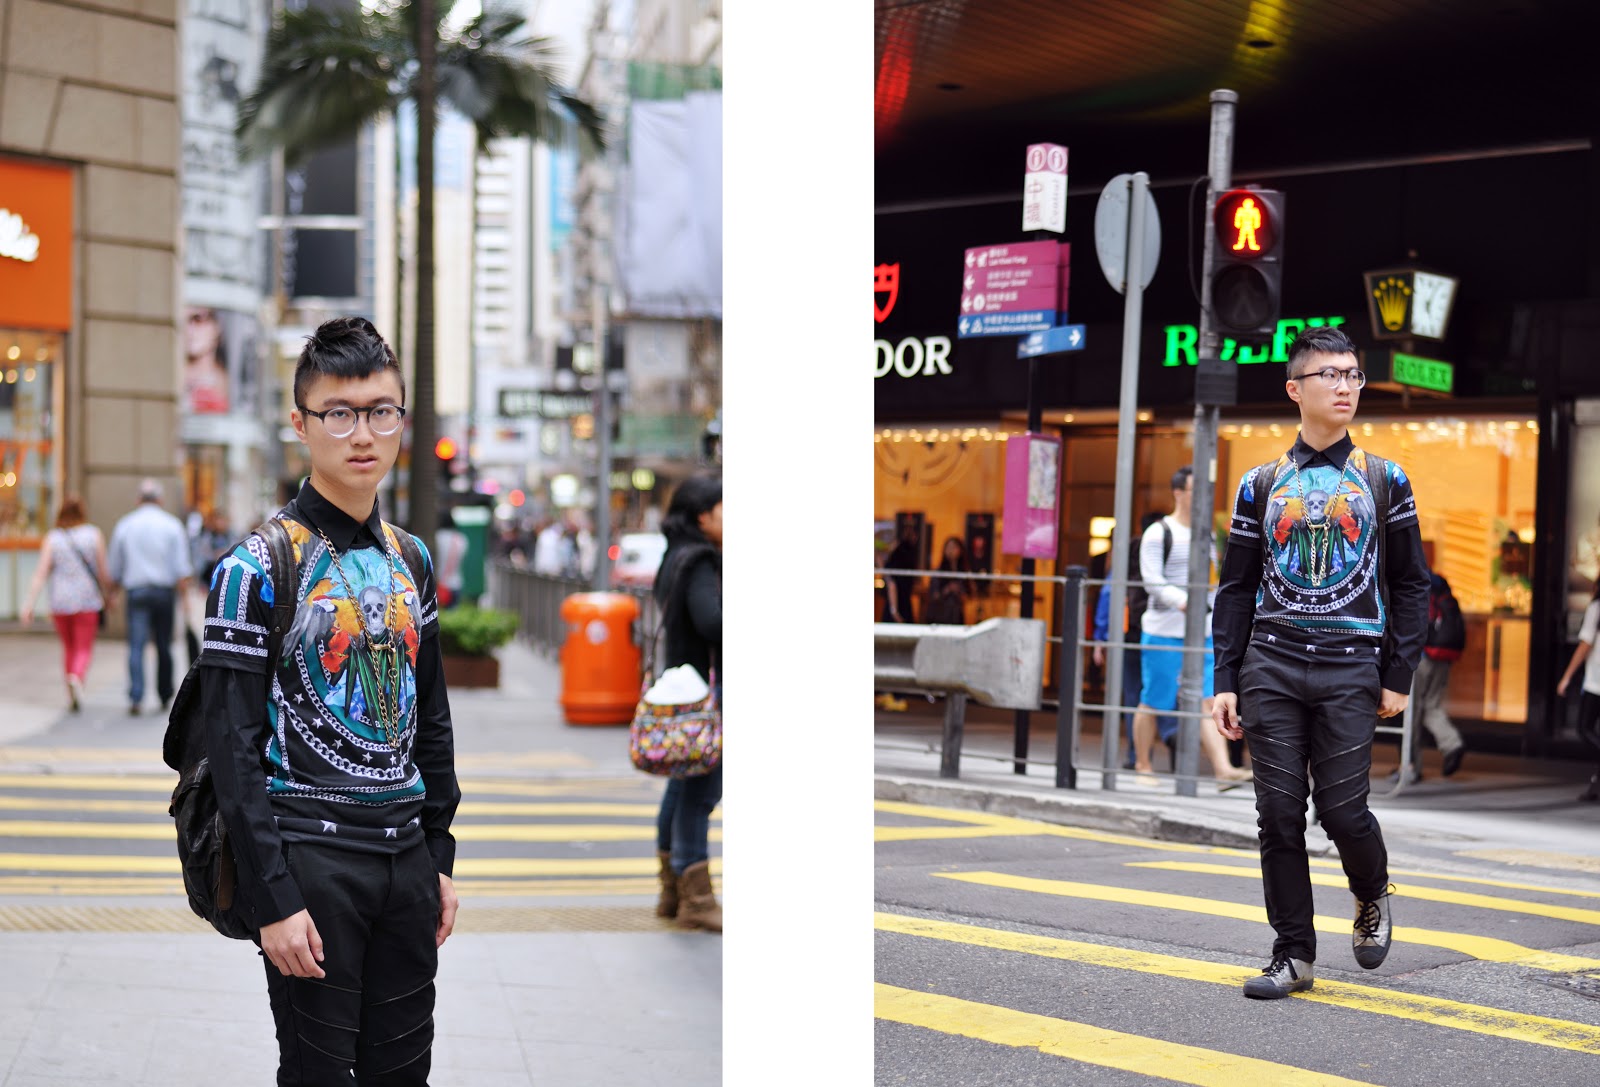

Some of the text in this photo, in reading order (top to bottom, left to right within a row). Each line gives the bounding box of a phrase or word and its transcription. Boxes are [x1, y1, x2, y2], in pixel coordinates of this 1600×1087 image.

[1026, 179, 1043, 223] 中環
[874, 336, 953, 378] DOR
[1395, 360, 1448, 386] ROLEX
